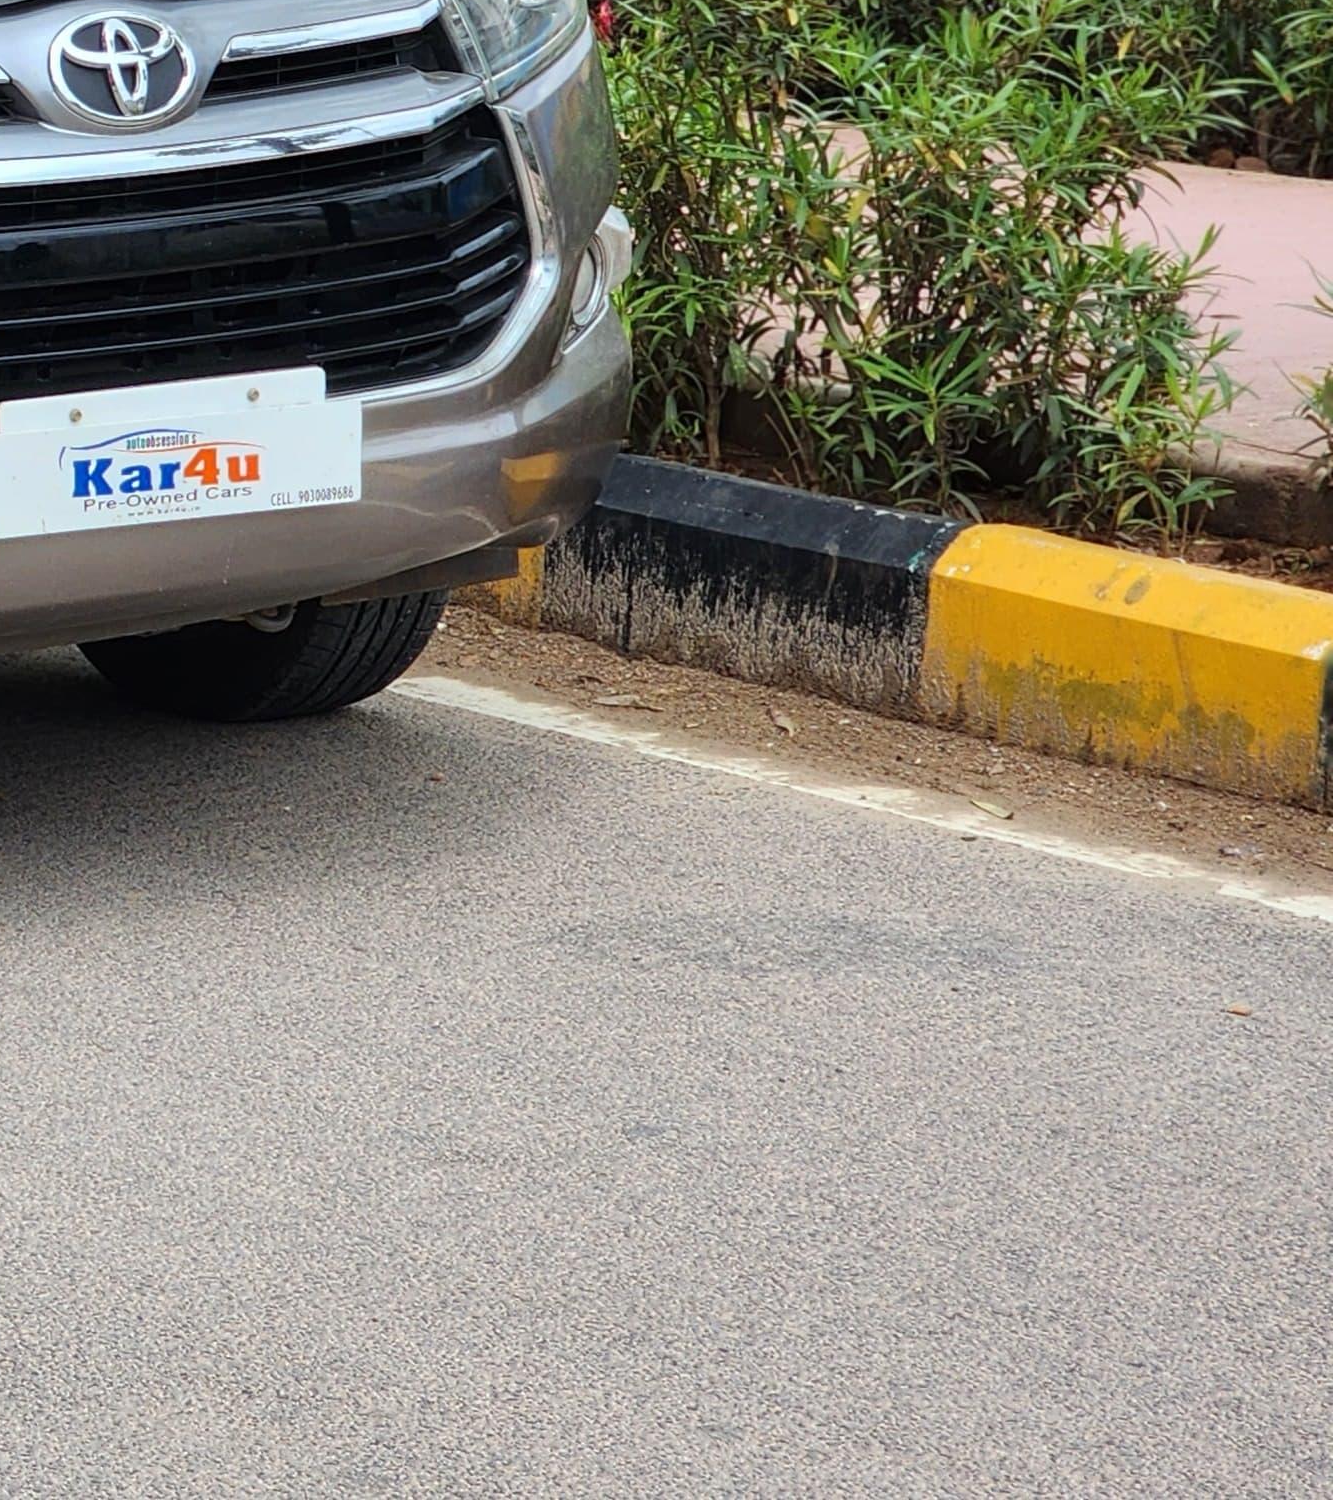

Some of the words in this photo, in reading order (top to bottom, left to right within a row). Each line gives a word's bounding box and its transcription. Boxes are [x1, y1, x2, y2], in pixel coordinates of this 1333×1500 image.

[72, 448, 260, 497] Kar4u
[83, 489, 198, 512] Pre-Owned
[205, 486, 252, 500] Cars
